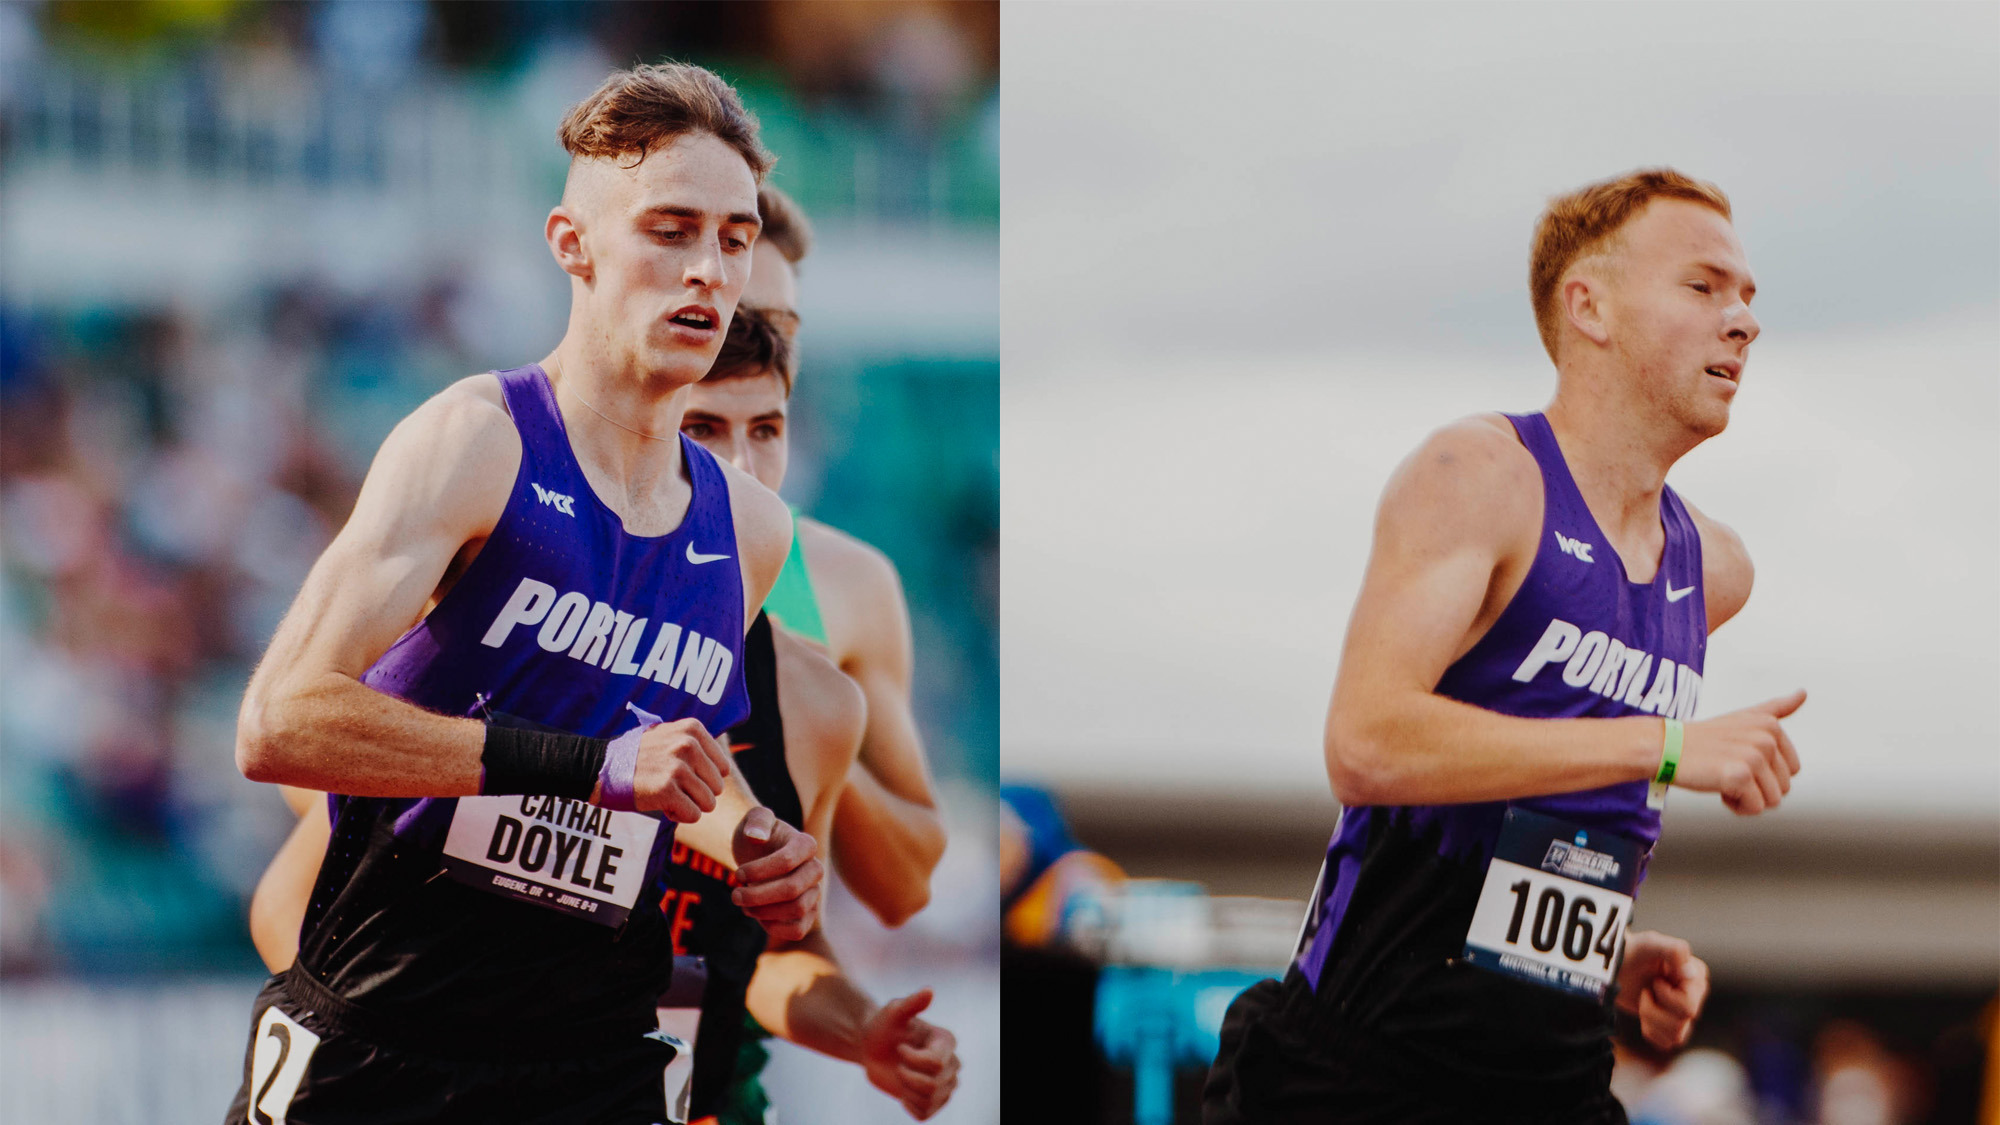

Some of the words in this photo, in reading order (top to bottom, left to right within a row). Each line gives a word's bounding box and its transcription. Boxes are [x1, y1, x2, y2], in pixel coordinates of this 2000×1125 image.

[480, 576, 734, 706] PORTLAND
[486, 814, 624, 895] DOYLE
[520, 795, 613, 840] CATHAL
[528, 885, 544, 898] OR
[556, 893, 582, 909] JUNE
[1505, 879, 1620, 971] 1064
[254, 1022, 291, 1125] 2
